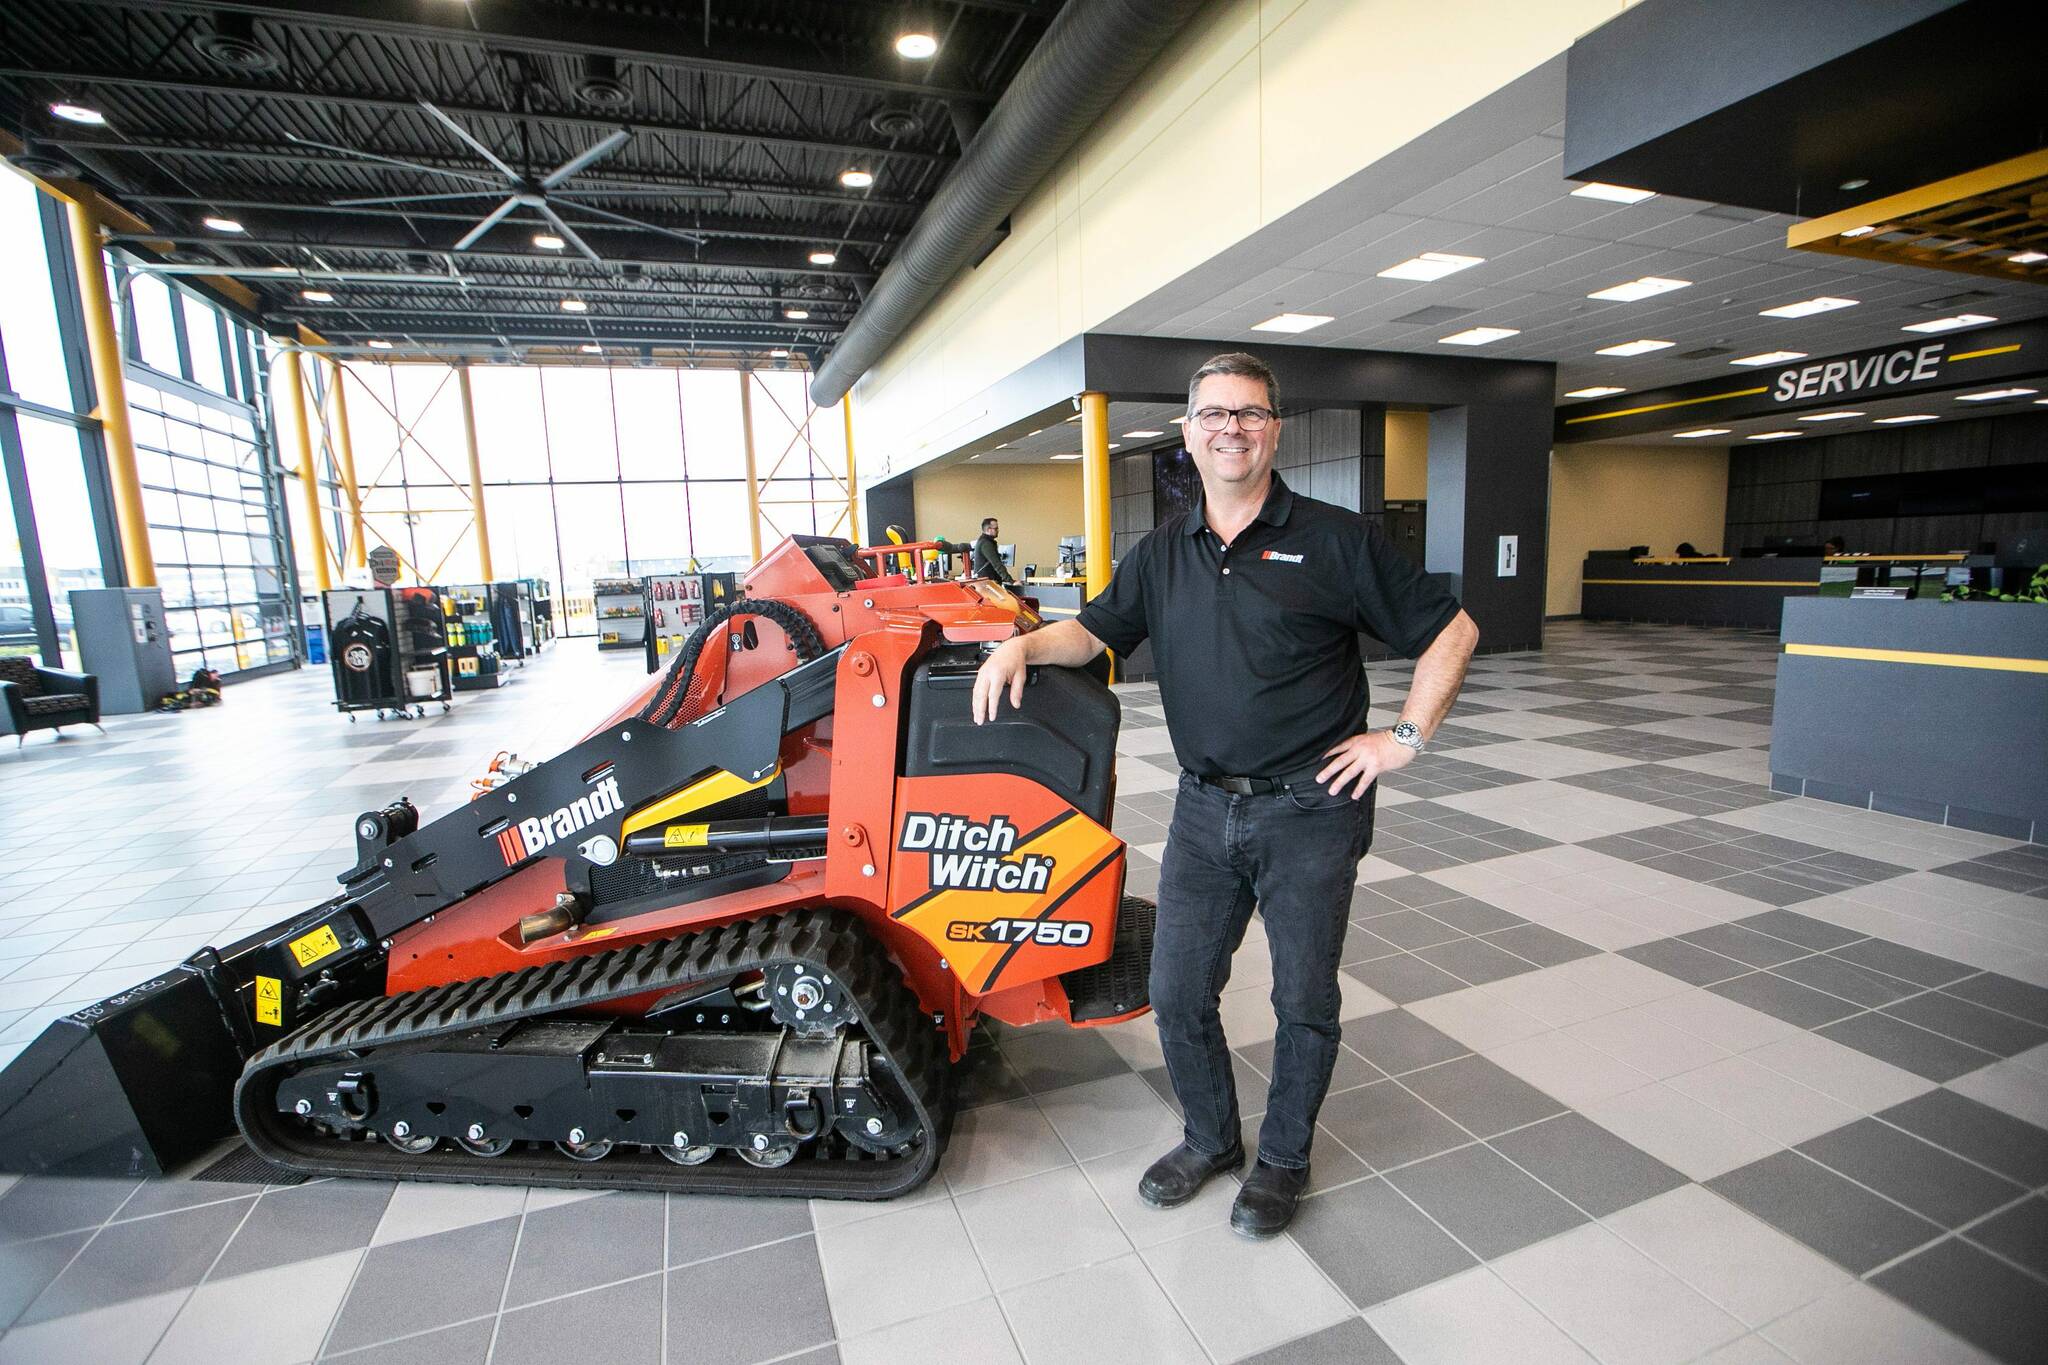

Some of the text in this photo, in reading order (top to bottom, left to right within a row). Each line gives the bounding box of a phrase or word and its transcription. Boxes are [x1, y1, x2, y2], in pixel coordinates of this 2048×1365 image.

[1774, 343, 1945, 402] SERVICE
[1269, 551, 1304, 563] Brandt
[518, 775, 625, 856] Brandt
[902, 815, 1016, 852] Ditch
